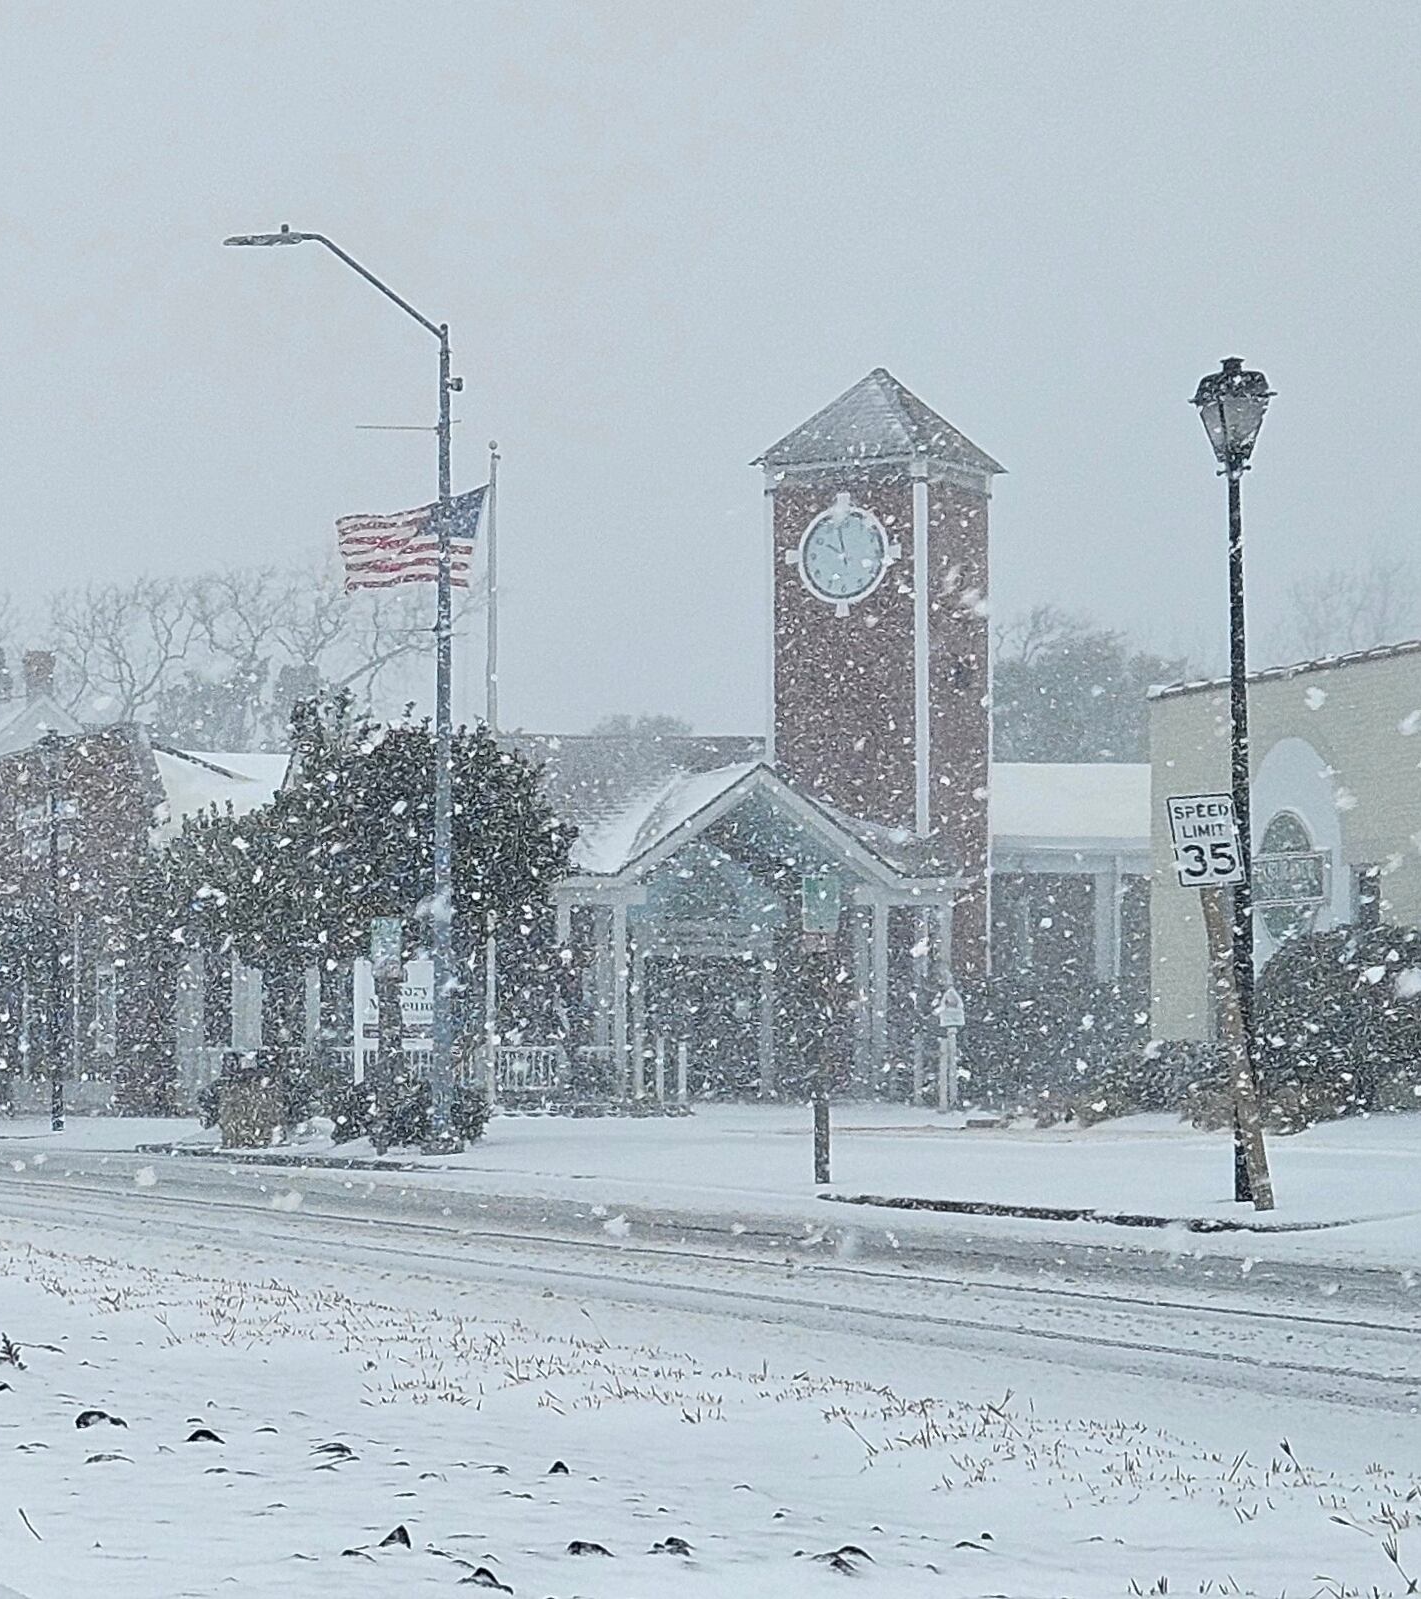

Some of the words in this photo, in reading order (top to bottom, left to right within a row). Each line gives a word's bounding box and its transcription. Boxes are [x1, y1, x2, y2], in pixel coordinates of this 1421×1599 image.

[1174, 804, 1229, 819] SPEED
[1182, 823, 1226, 838] LIMIT
[1182, 842, 1236, 877] 35
